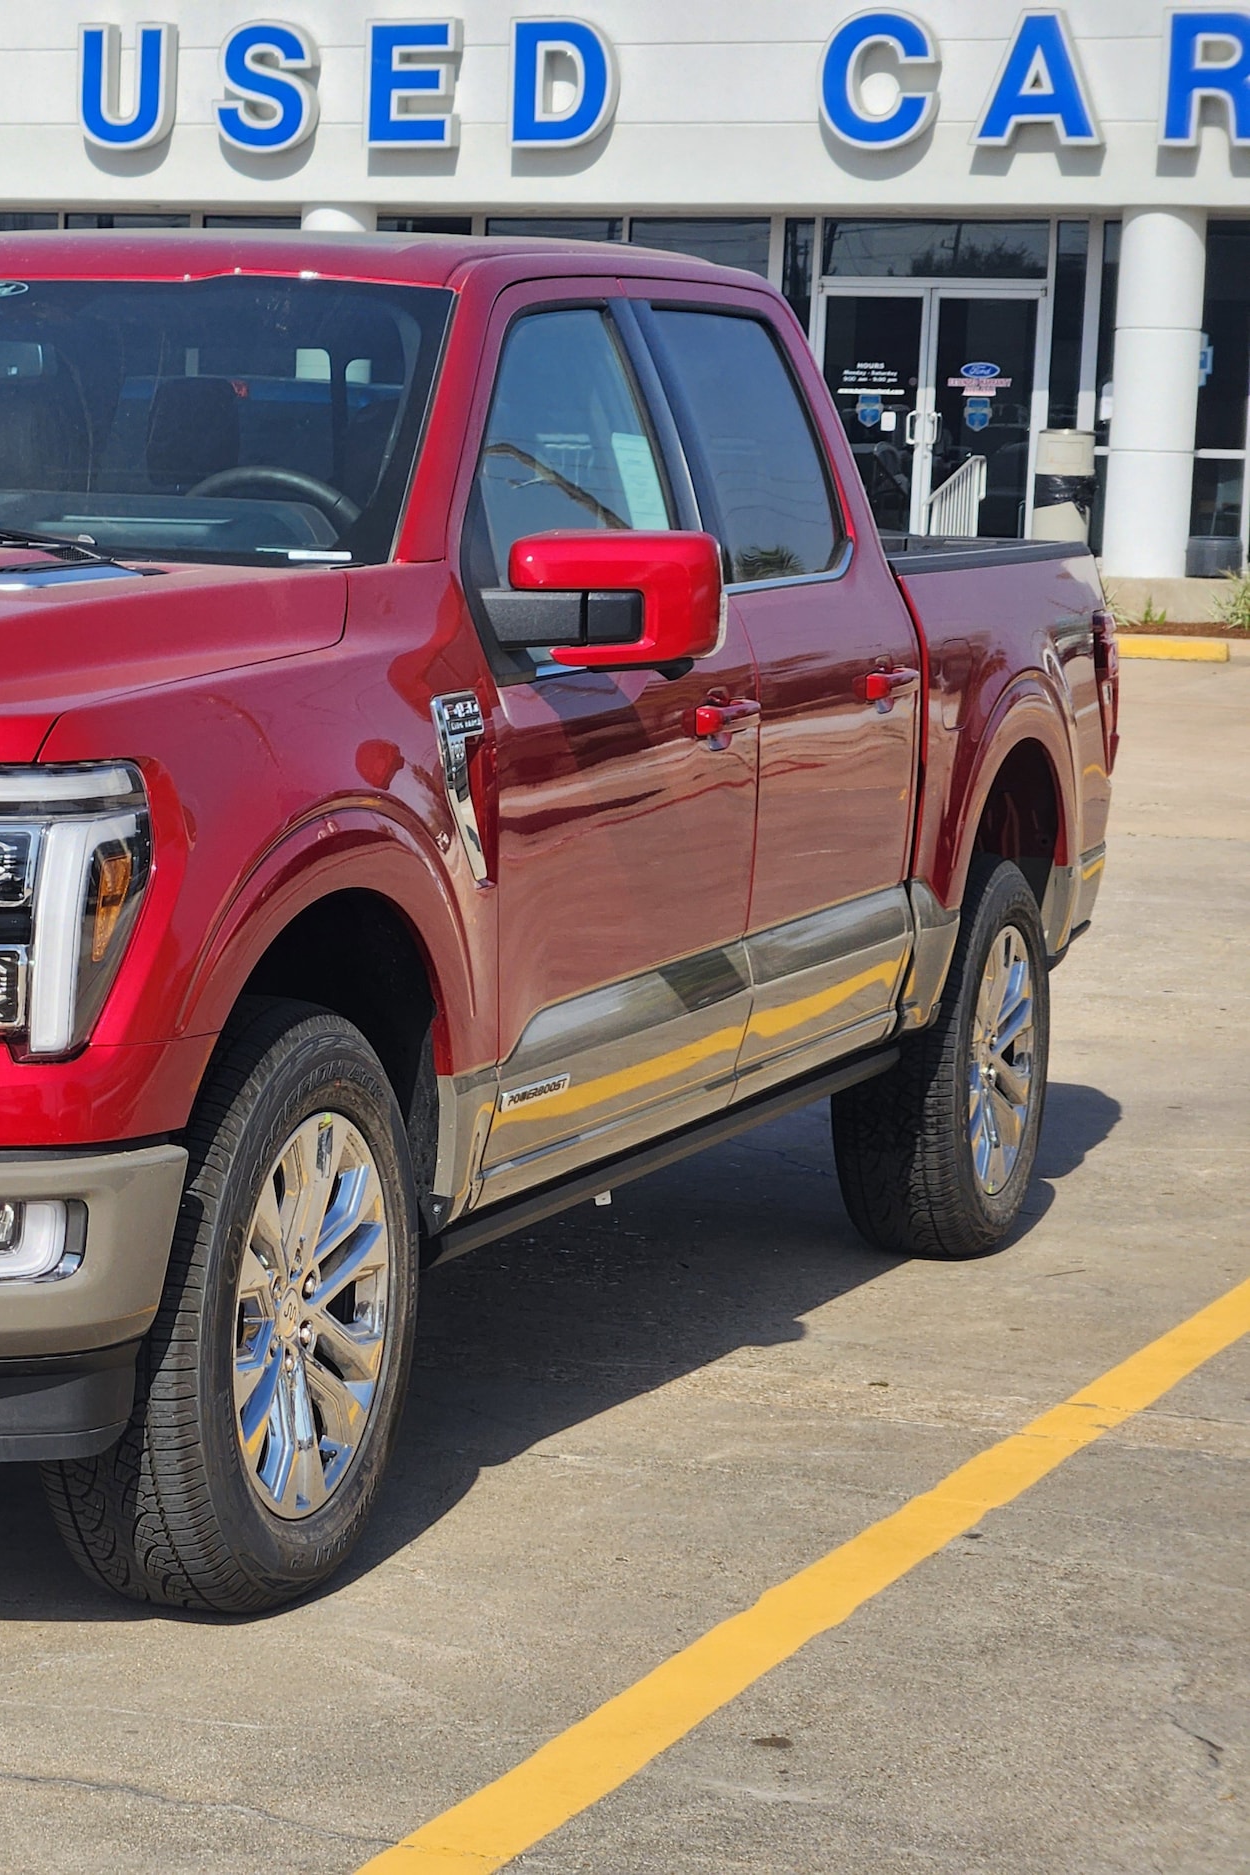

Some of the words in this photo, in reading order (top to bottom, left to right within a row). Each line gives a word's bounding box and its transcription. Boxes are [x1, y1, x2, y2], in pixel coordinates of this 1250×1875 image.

[78, 16, 619, 153] USED
[817, 7, 1250, 150] CAR
[856, 362, 886, 370] HOURS
[507, 1078, 568, 1107] POWERBOOST
